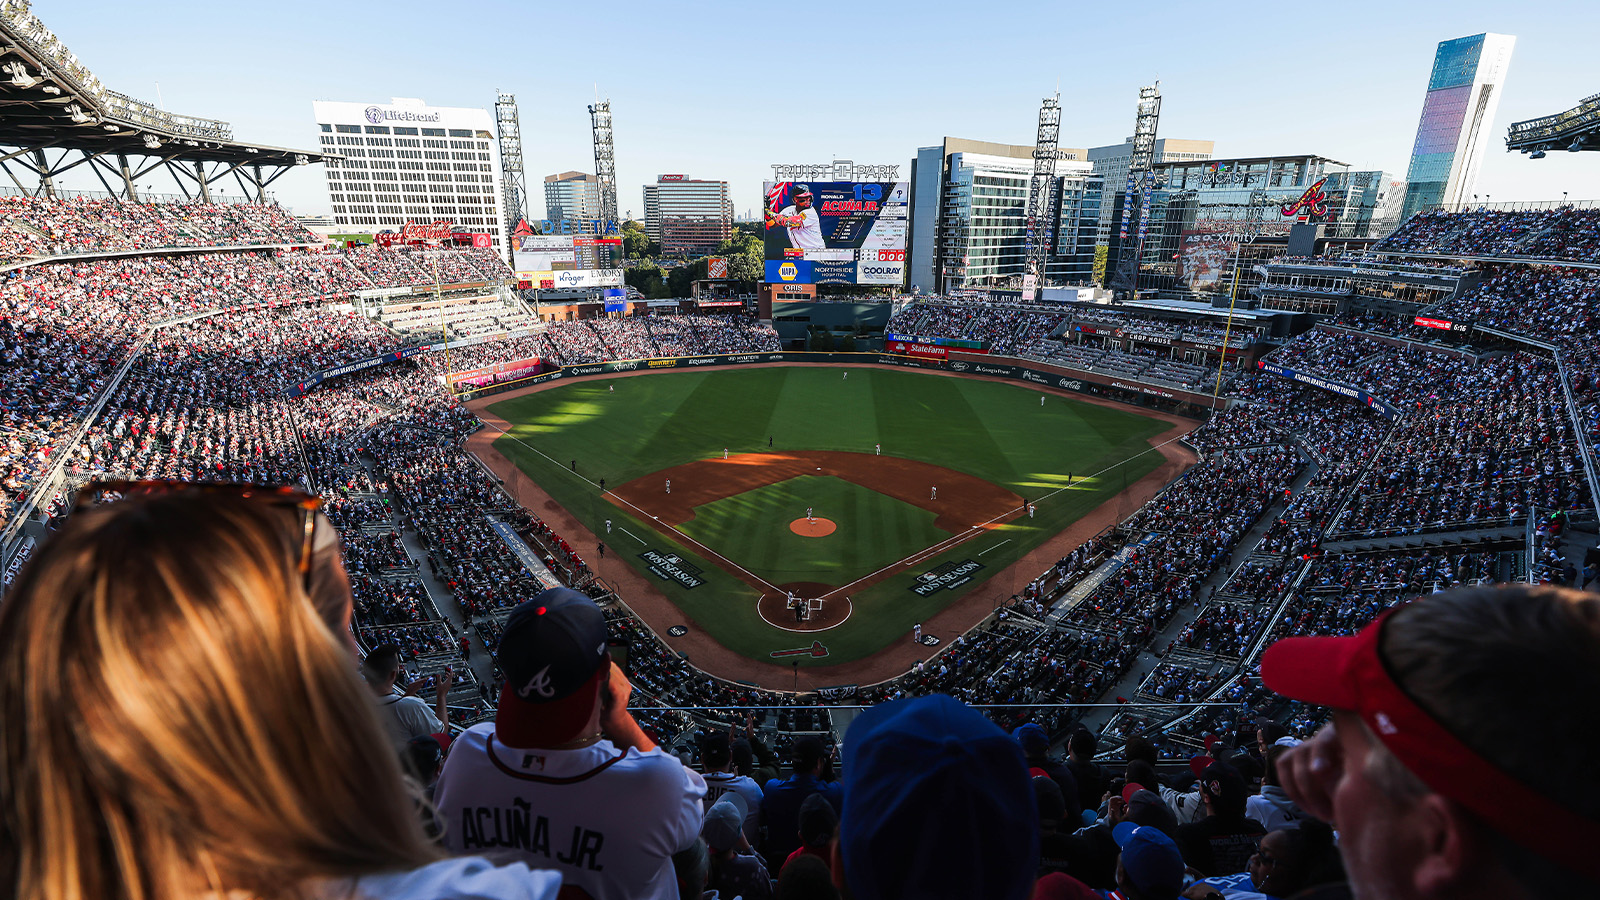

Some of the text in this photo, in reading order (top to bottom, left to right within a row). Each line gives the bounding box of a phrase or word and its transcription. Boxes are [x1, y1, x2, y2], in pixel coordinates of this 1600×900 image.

[384, 110, 441, 122] LifeBrand
[771, 164, 900, 179] TRUIST PARK
[853, 184, 883, 201] 13
[821, 199, 862, 211] ACUÑA
[863, 201, 880, 211] JR.
[403, 220, 454, 239] Coca-Cola
[541, 220, 619, 234] DELTA
[1218, 231, 1258, 245] xfinity
[591, 270, 622, 278] EMORY
[709, 258, 727, 278] HOME
[781, 267, 797, 275] NAPA
[864, 267, 902, 275] COOLRAY
[559, 271, 585, 286] Kroger
[1081, 325, 1096, 334] Coors
[1148, 337, 1171, 345] HOUSE
[613, 361, 638, 372] xfinity
[1268, 365, 1283, 374] DELTA
[323, 369, 341, 378] ATLANTA
[1294, 373, 1311, 384] ATLANTA
[1059, 378, 1082, 390] Coca-Cola
[643, 551, 701, 587] POSTSEASON
[915, 561, 980, 595] POSTSEASON
[462, 797, 605, 872] ACUÑA JR.
